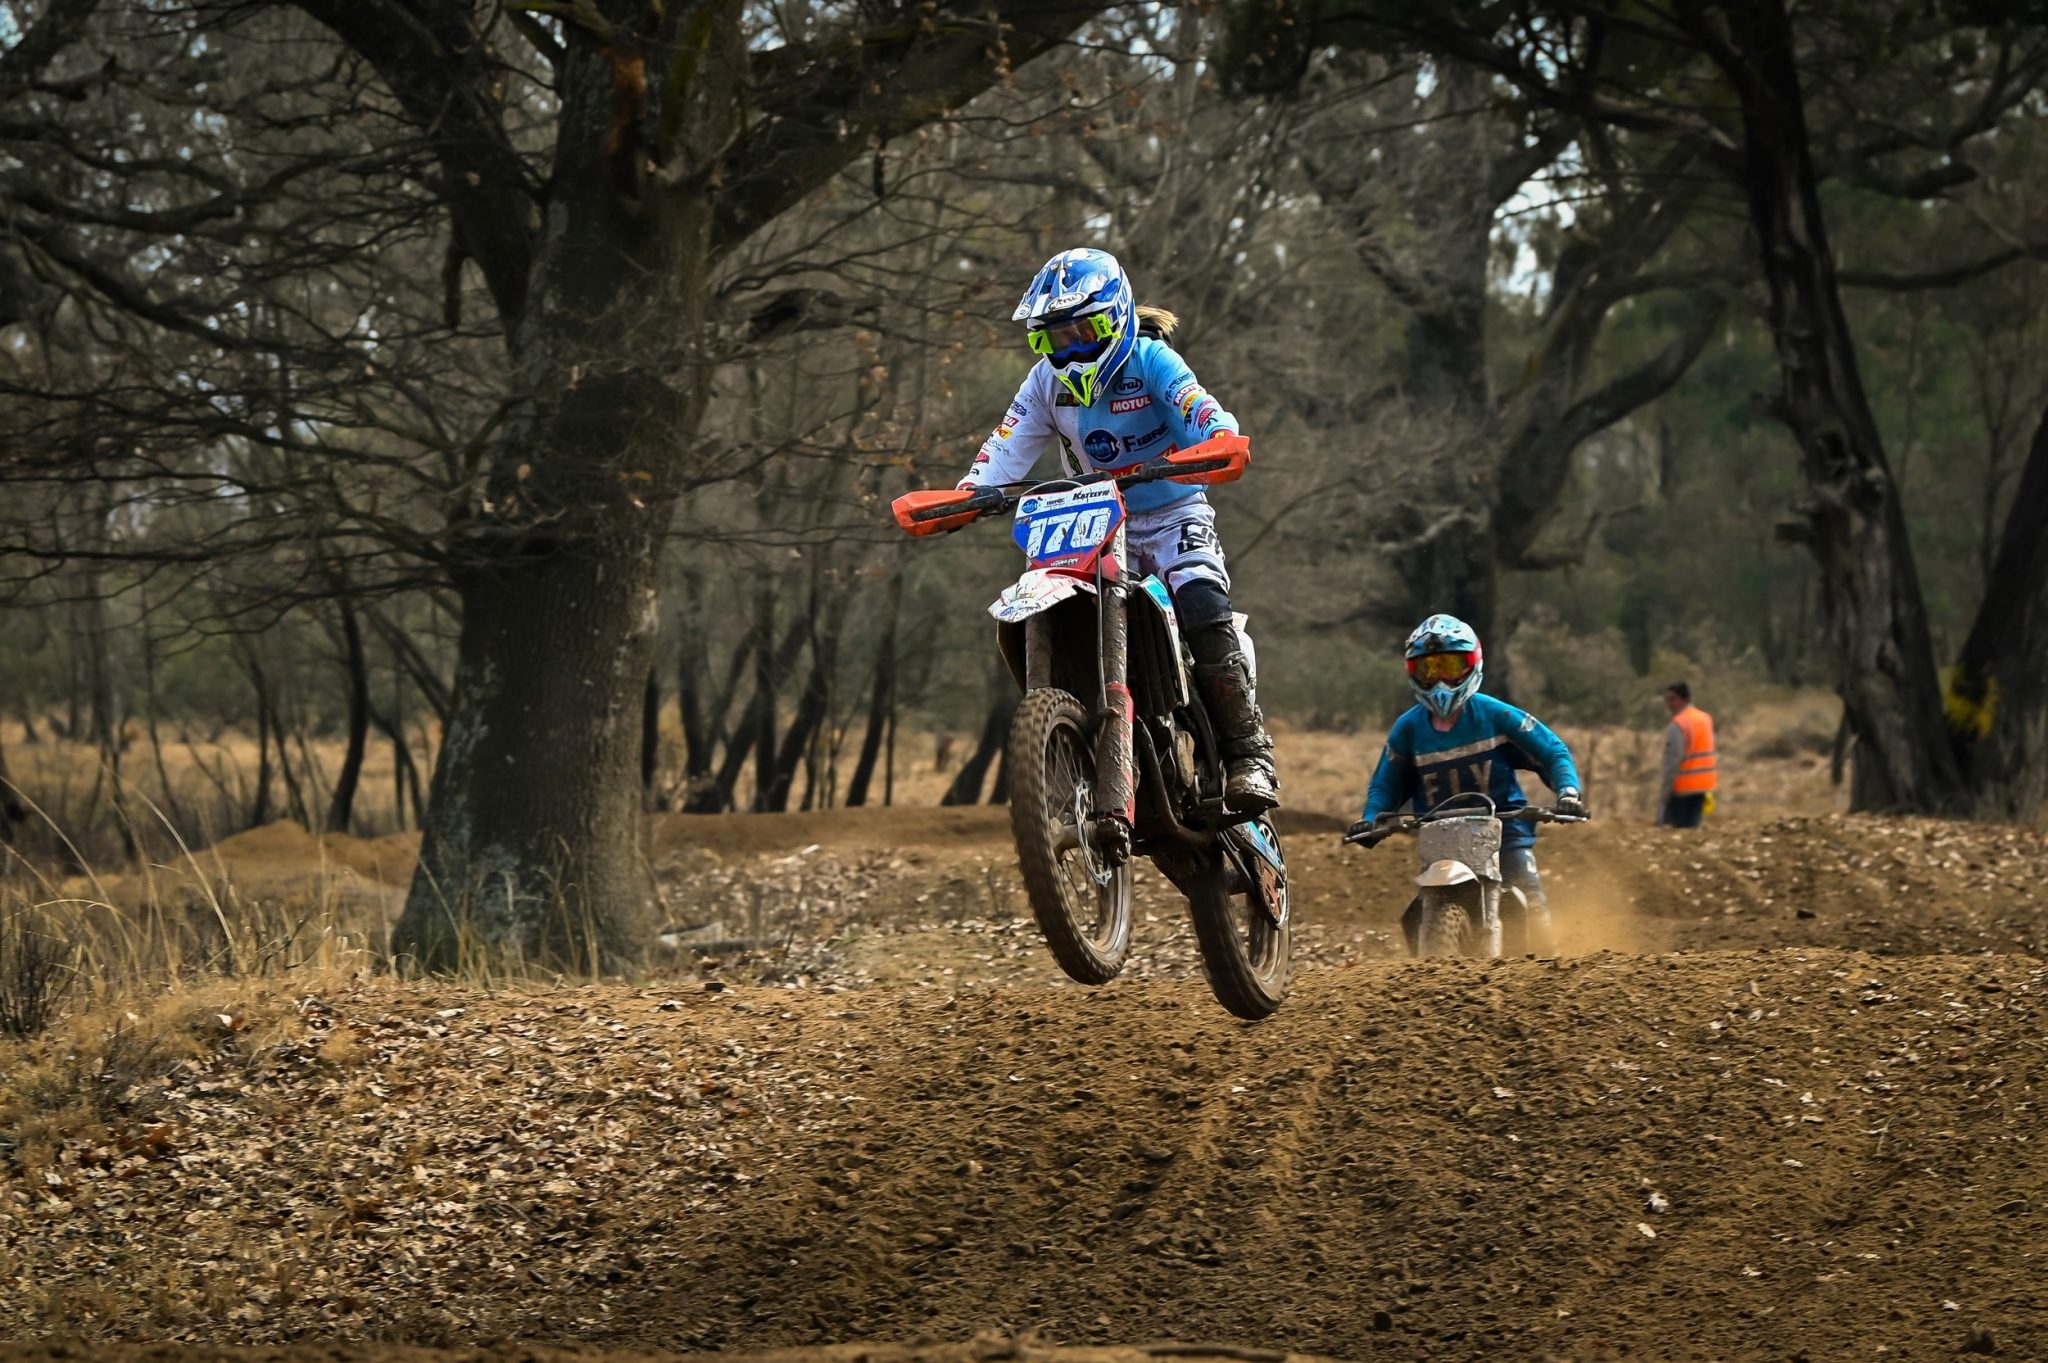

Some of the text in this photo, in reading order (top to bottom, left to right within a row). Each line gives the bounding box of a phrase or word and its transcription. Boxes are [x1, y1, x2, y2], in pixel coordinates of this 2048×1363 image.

[1112, 396, 1151, 412] MOTUL
[1026, 507, 1112, 559] 170
[1423, 759, 1492, 806] FLY
